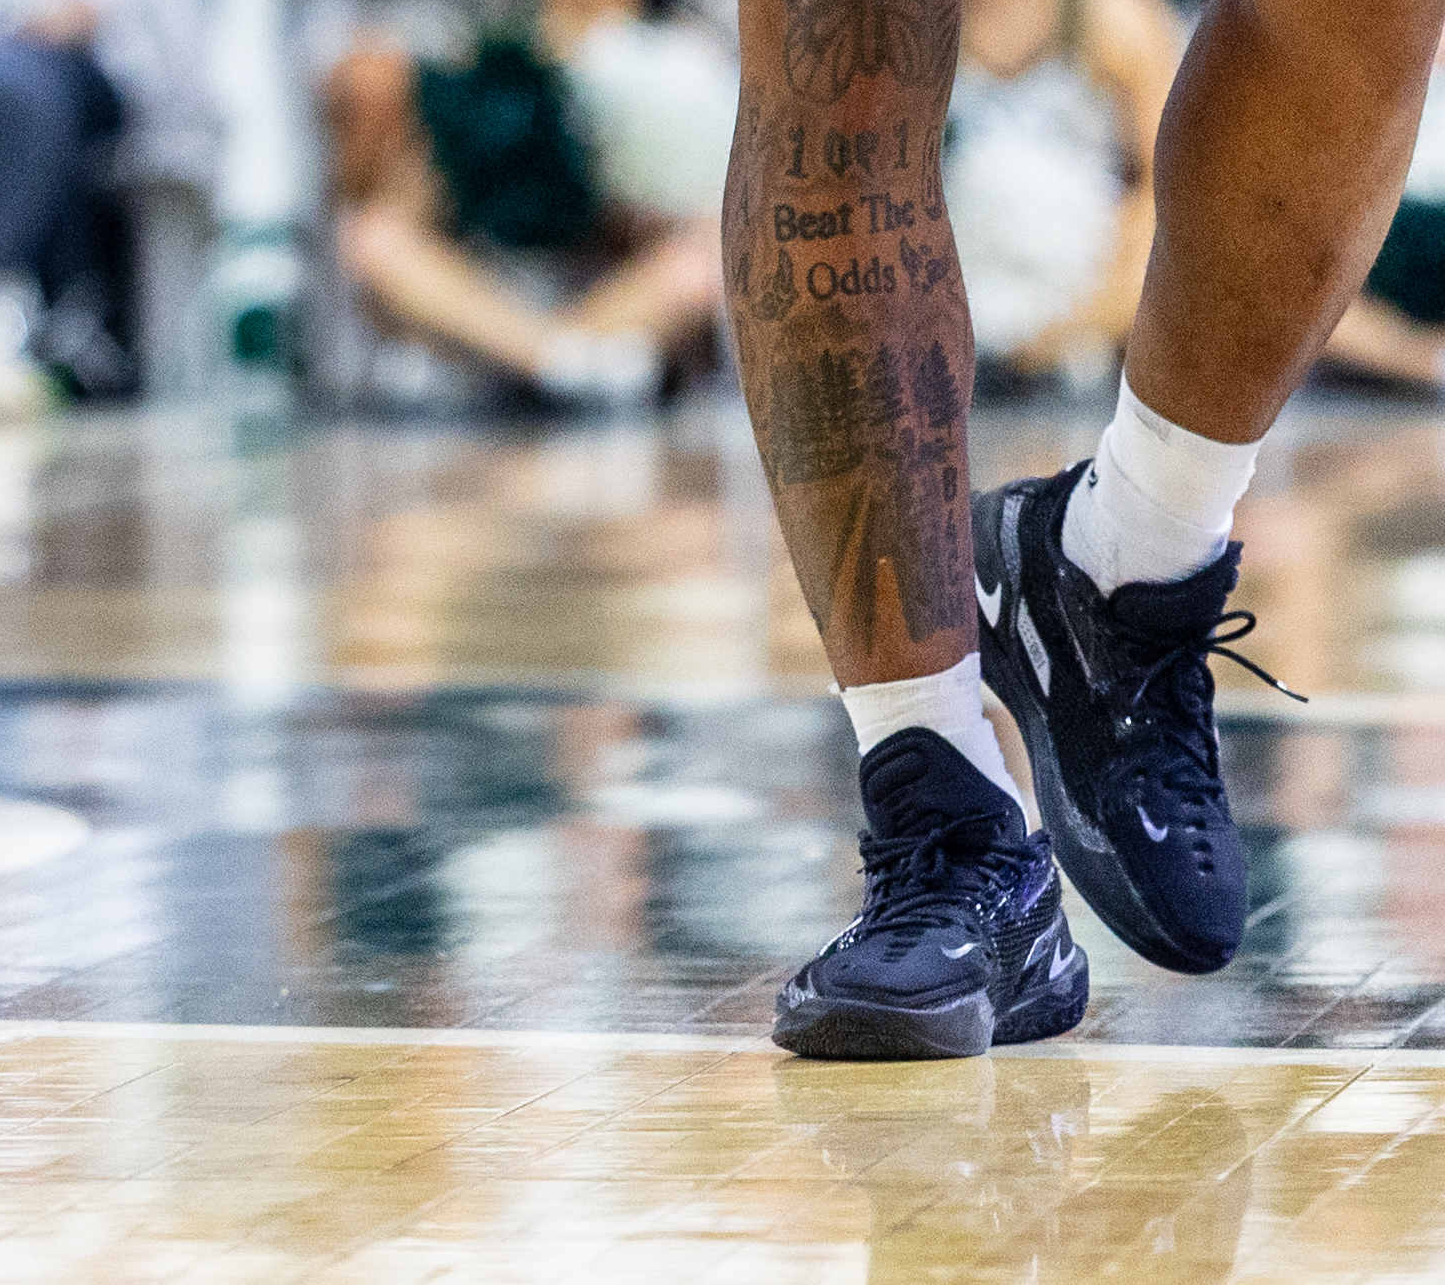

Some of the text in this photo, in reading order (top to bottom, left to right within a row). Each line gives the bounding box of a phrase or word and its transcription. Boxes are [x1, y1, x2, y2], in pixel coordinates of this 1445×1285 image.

[773, 191, 915, 243] Beat The
[807, 256, 897, 300] Odds
